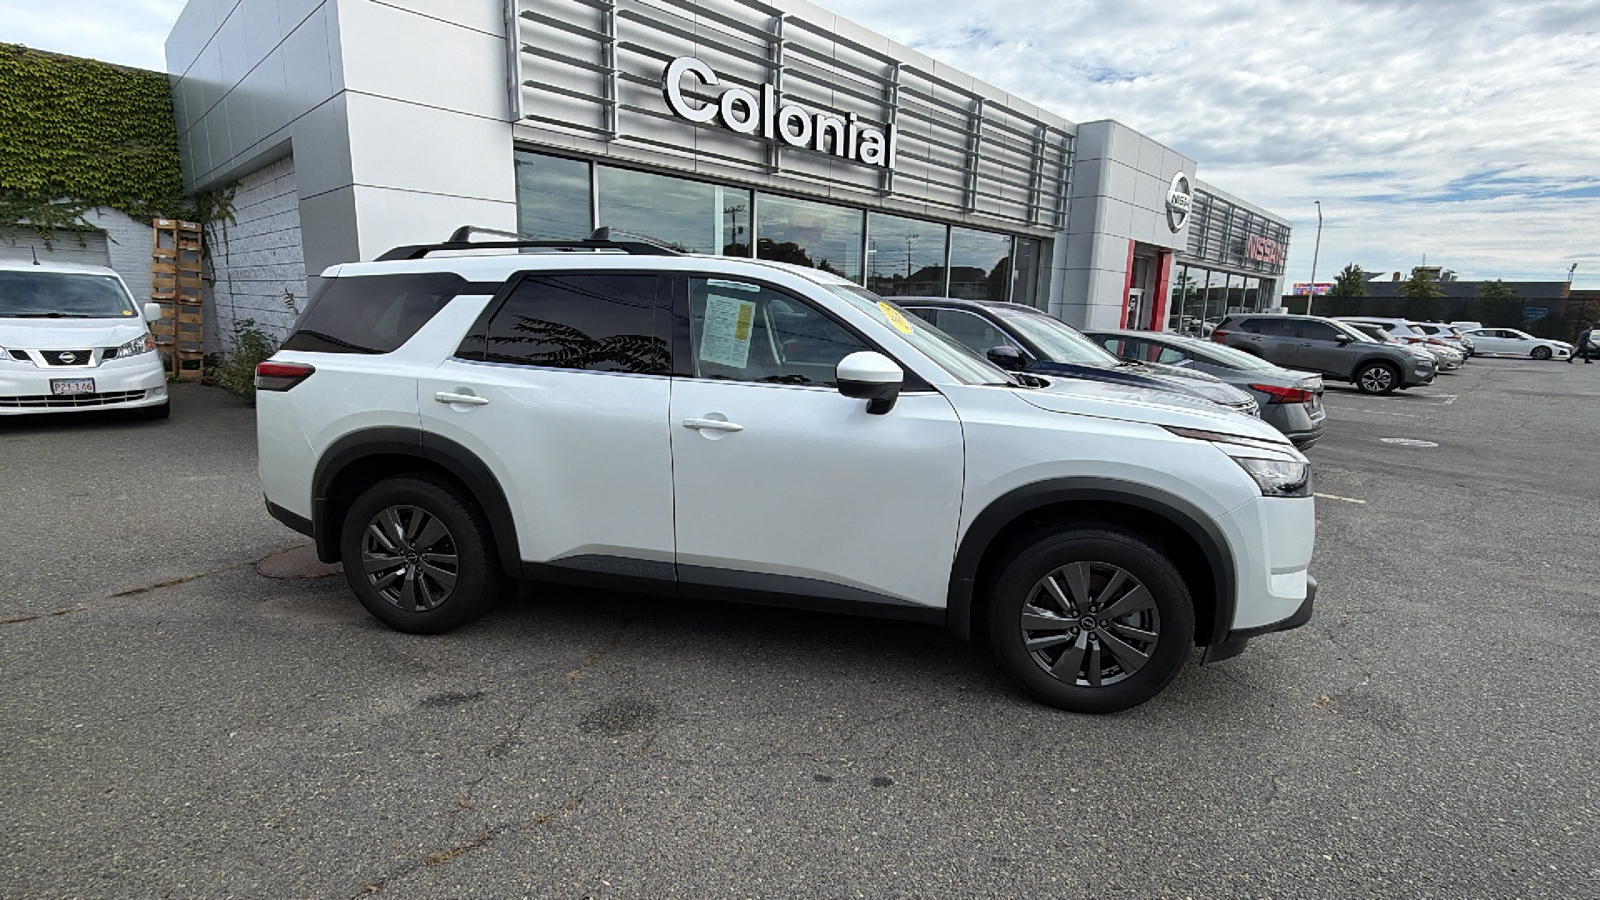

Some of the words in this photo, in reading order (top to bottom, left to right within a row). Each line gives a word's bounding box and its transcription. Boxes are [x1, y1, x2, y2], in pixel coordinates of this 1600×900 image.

[662, 55, 897, 169] Colonial
[1171, 193, 1190, 208] NISS
[1247, 233, 1285, 266] NISSAN
